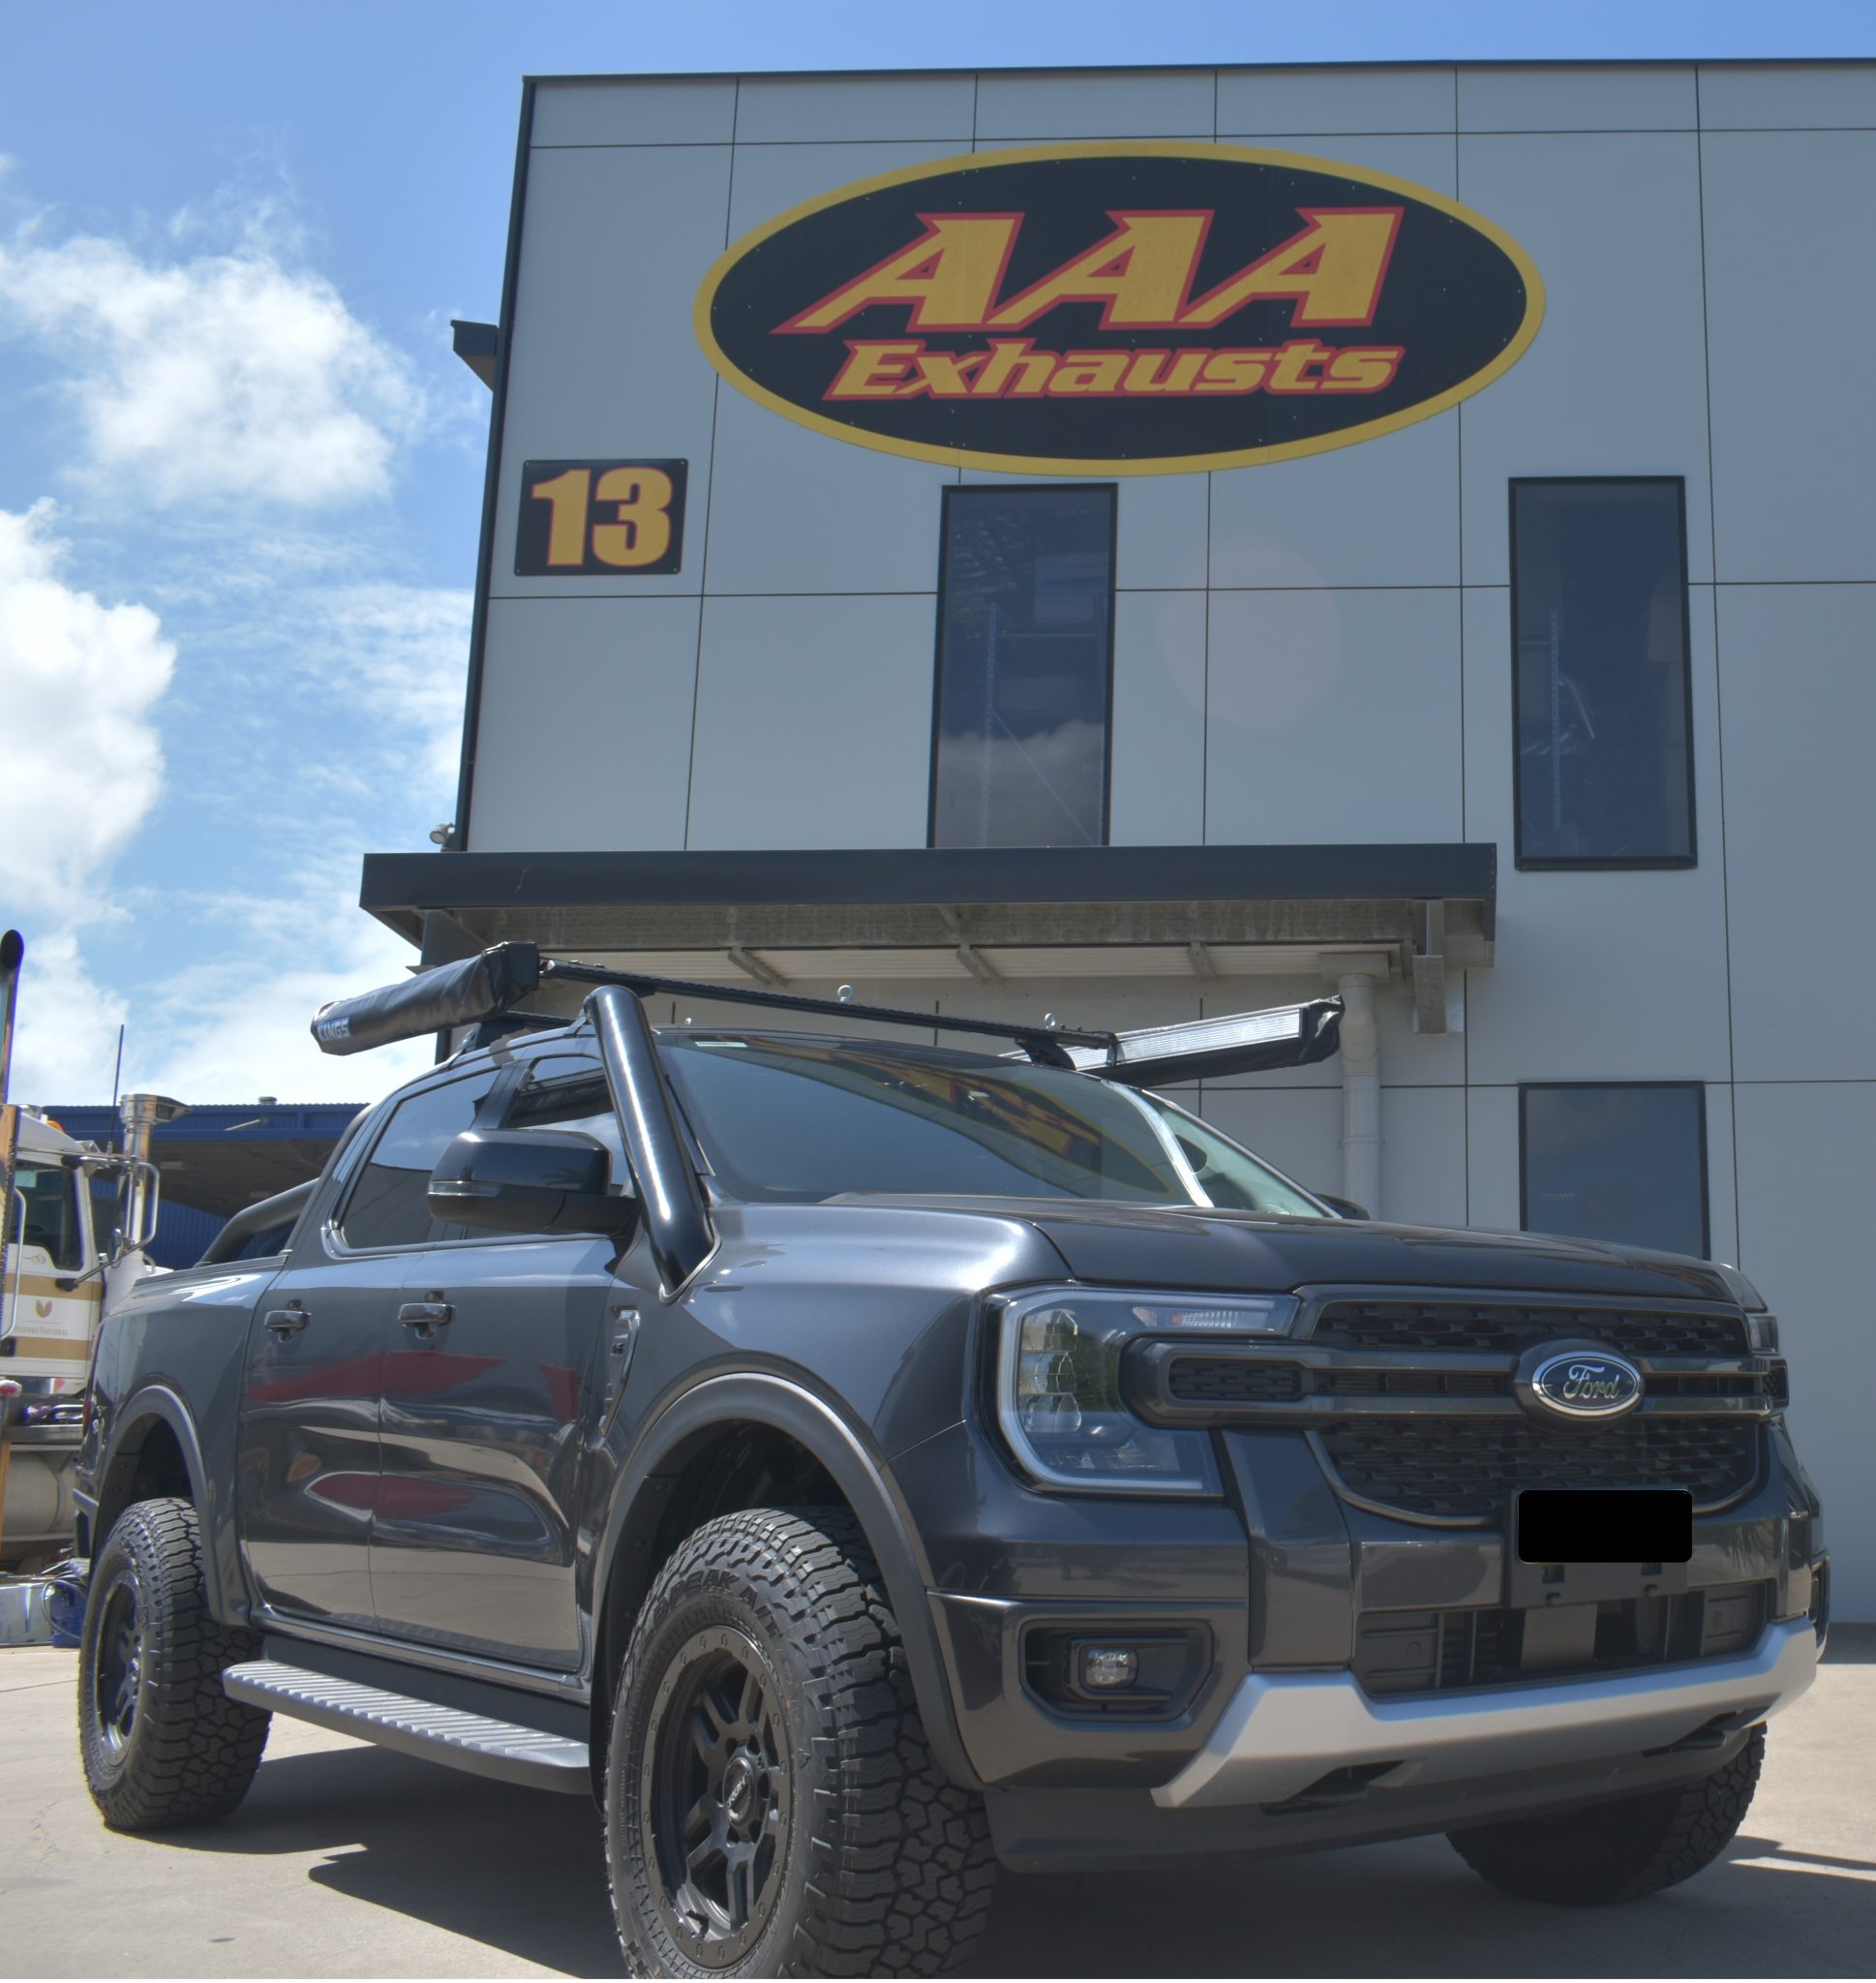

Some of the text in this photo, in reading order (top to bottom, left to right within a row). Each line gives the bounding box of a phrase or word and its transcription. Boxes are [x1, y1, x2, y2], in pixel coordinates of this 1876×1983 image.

[769, 206, 1406, 334] AAA
[823, 338, 1406, 400] Exhausts
[531, 466, 673, 567] 13
[317, 1020, 350, 1042] KINGS
[1563, 1364, 1619, 1399] Ford
